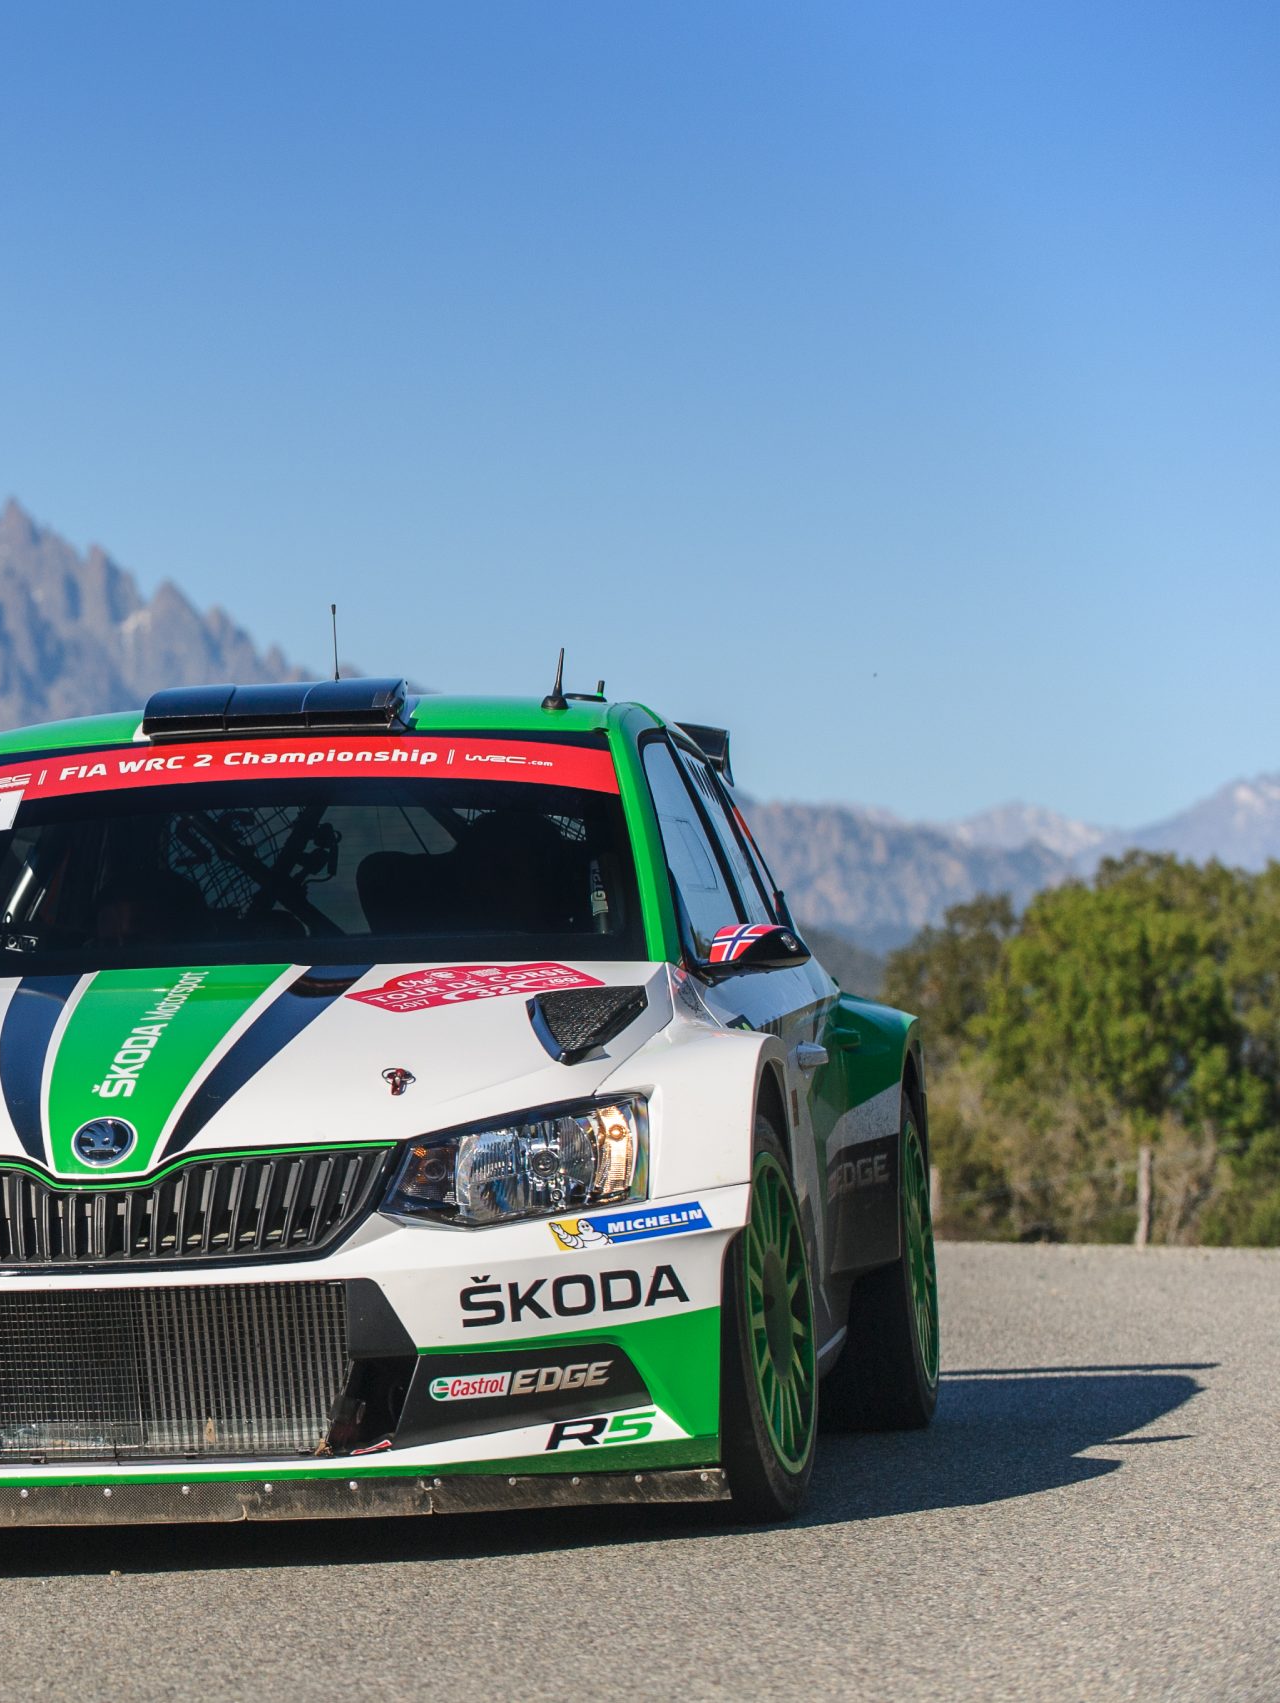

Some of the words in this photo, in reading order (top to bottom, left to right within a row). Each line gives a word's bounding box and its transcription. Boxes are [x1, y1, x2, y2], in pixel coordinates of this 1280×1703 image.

[59, 764, 107, 781] FIA
[119, 755, 185, 773] WRC
[195, 754, 213, 767] 2
[223, 749, 438, 765] Championship
[371, 985, 445, 1003] TOUR
[448, 979, 486, 989] DE
[489, 968, 573, 982] CORSE
[468, 985, 520, 998] 32
[392, 999, 431, 1010] 2017
[91, 1023, 169, 1098] ŠKODA
[140, 971, 210, 1021] Motorsport
[607, 1209, 703, 1234] MICHELIN
[459, 1264, 690, 1328] ŠKODA
[450, 1376, 505, 1397] Castrol
[510, 1360, 614, 1395] EDGE
[545, 1411, 657, 1450] R5
